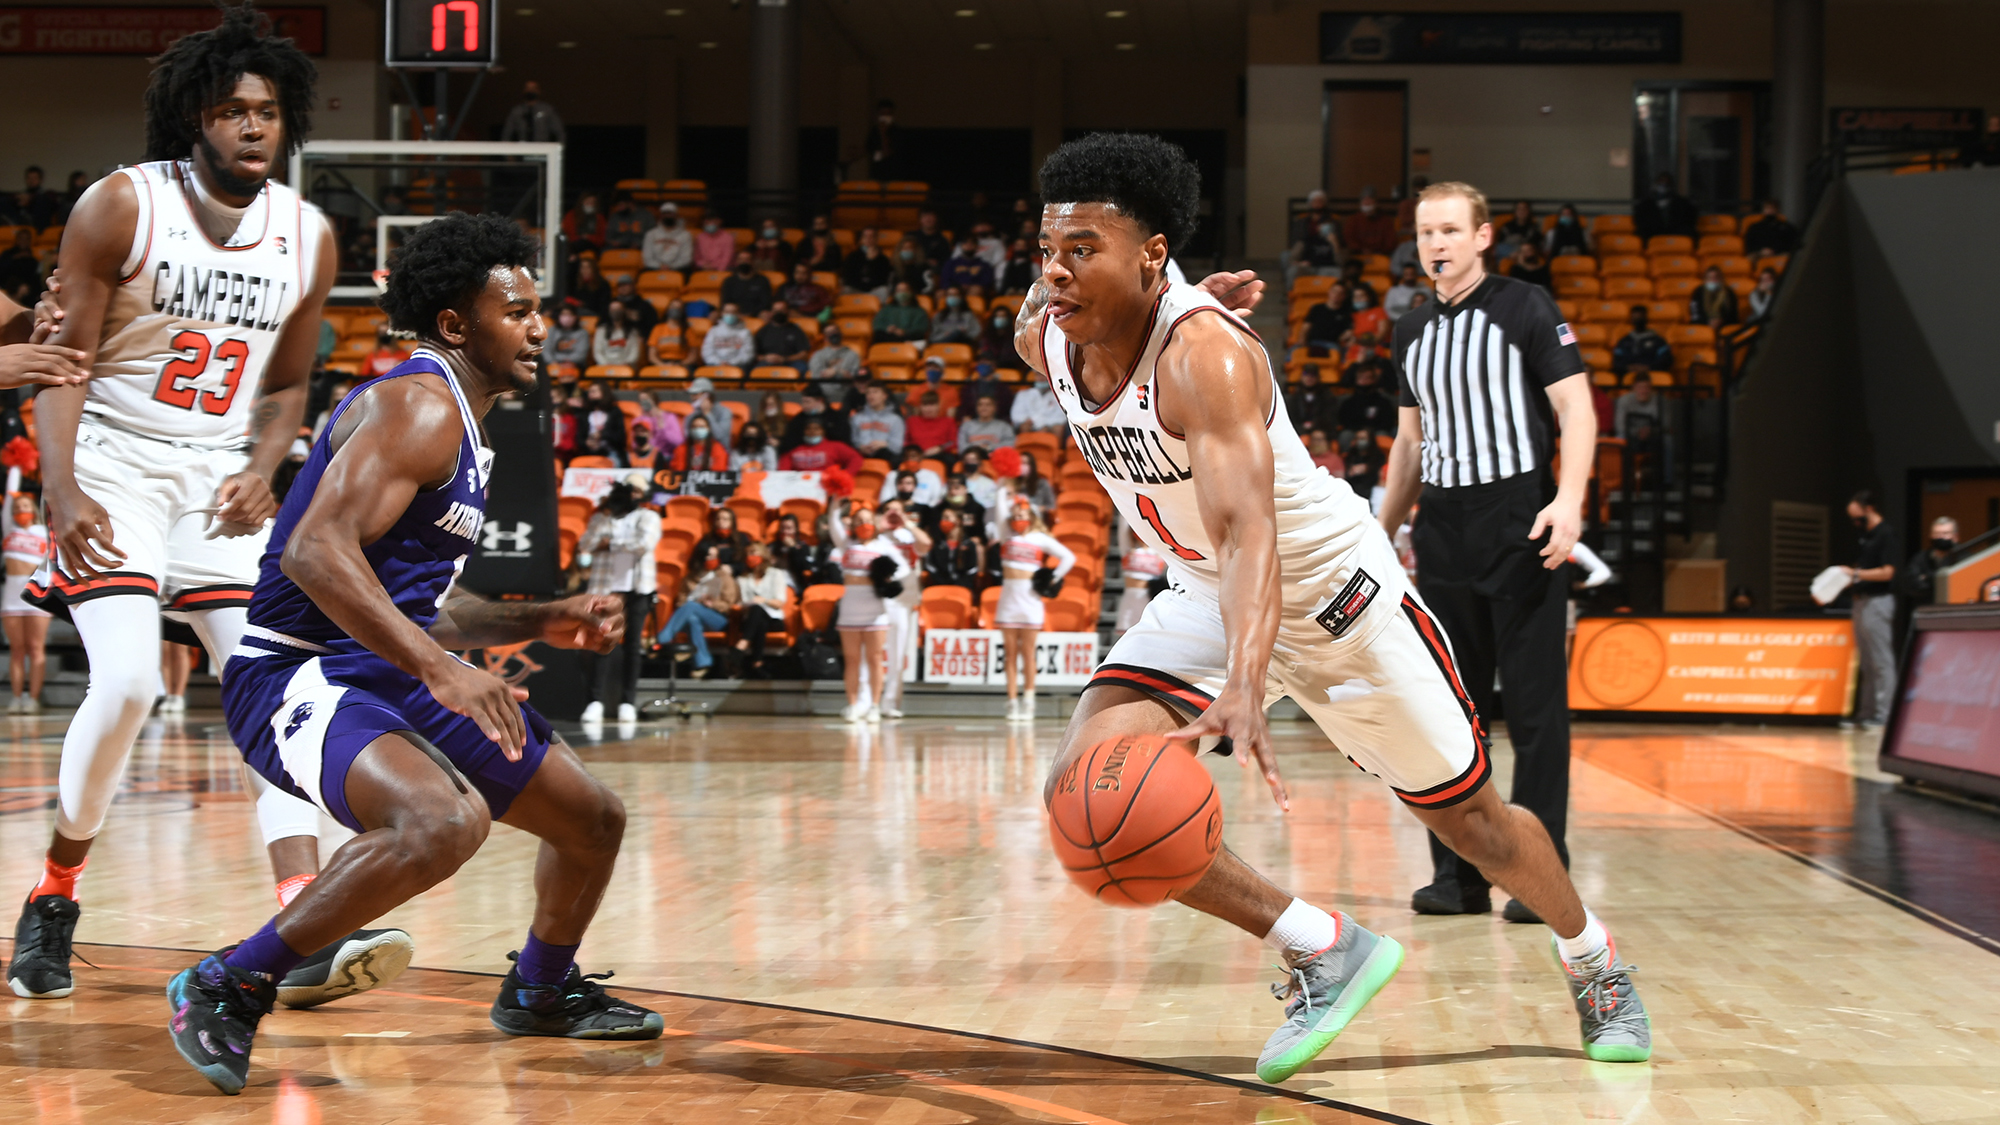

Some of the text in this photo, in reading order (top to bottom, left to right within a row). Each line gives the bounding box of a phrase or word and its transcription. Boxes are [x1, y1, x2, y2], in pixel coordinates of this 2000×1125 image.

[35, 28, 153, 49] FIGHTING
[431, 0, 479, 52] 17
[150, 260, 287, 332] CAMPBELL
[151, 328, 250, 417] 23
[1070, 420, 1193, 485] AMPBELL
[1135, 492, 1208, 561] 1
[1717, 632, 1762, 646] HILLS
[930, 655, 989, 677] NOIS
[1666, 665, 1840, 681] CAMPBELL UNIVERSITY
